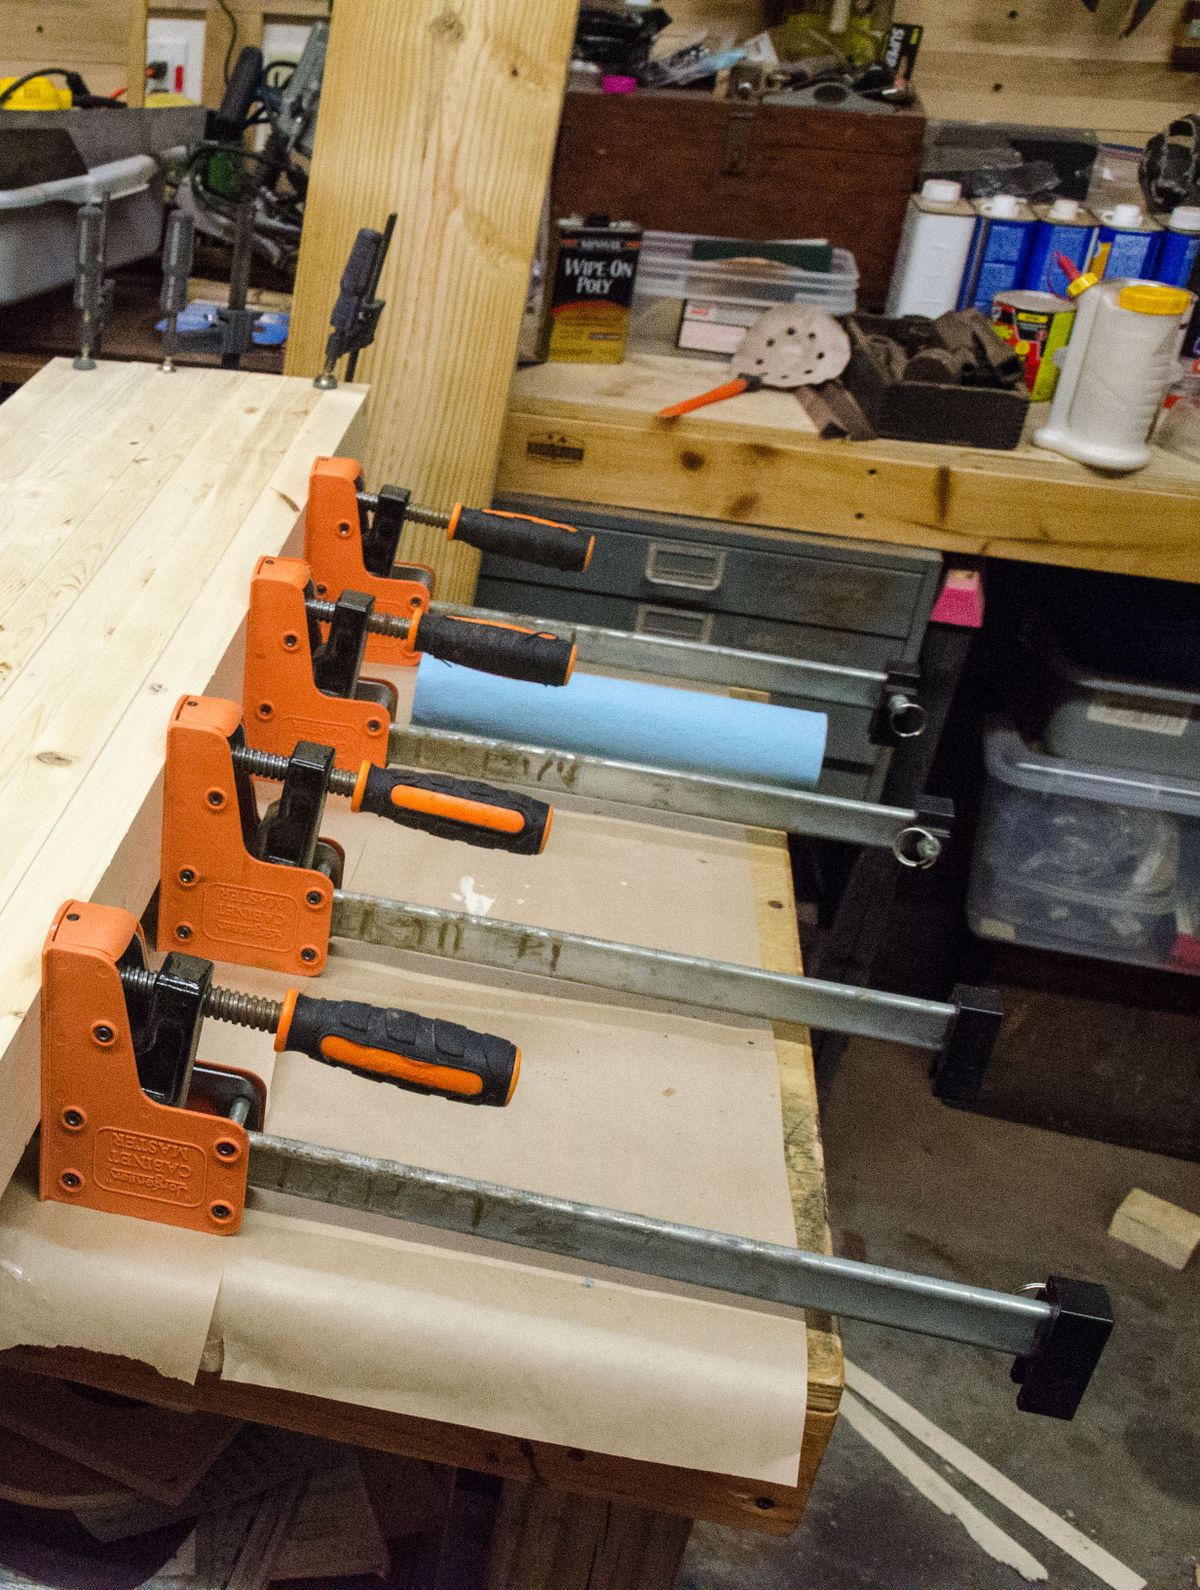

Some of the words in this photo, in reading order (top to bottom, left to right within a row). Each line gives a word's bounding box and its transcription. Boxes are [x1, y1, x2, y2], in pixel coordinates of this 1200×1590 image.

[576, 276, 613, 294] POLY
[111, 1132, 190, 1161] MASTER
[107, 1149, 192, 1179] CABINET
